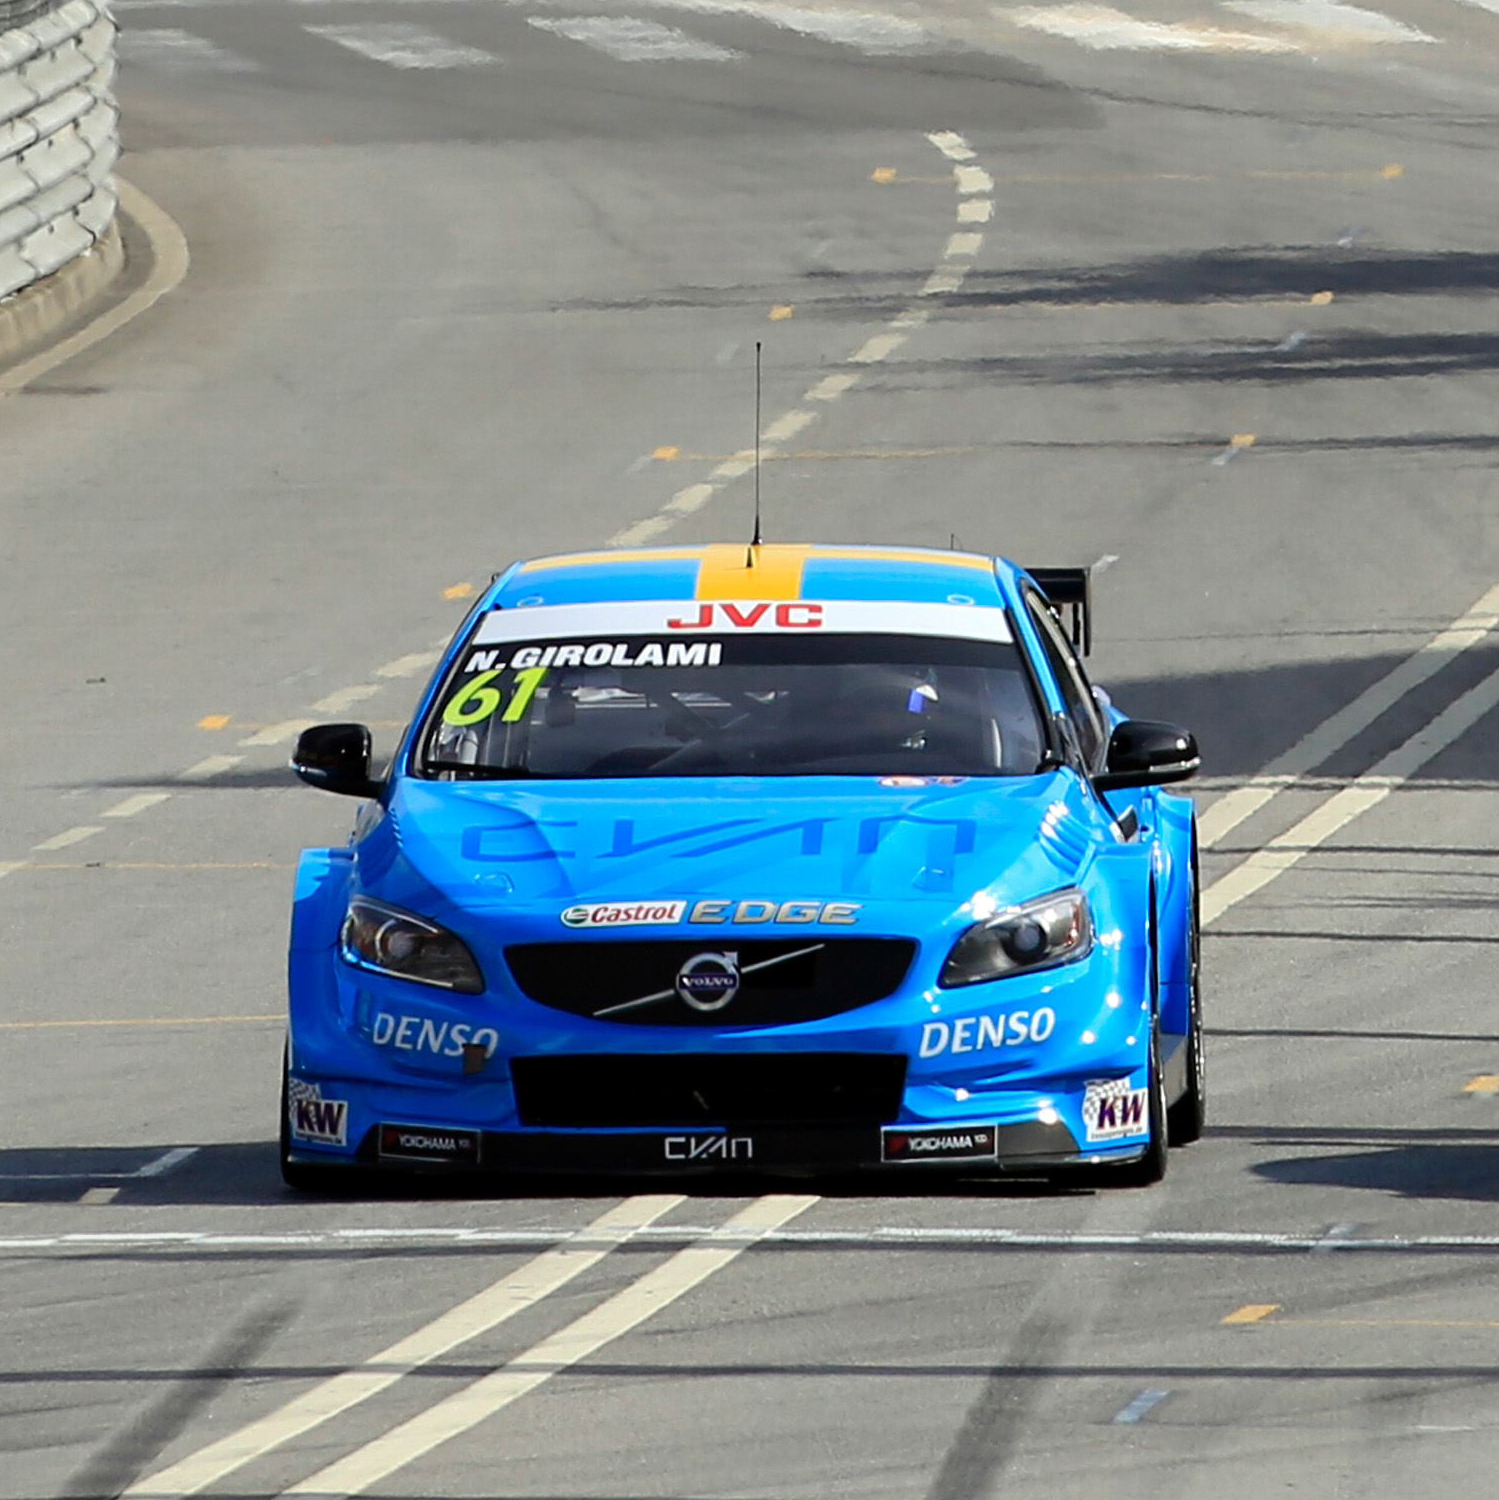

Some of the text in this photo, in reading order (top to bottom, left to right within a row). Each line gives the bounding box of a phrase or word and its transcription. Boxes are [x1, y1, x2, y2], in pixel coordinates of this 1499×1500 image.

[667, 603, 823, 629] JVC
[442, 666, 549, 727] 61
[590, 899, 864, 925] Castrol EDGE
[681, 976, 734, 987] VOLVO
[372, 1012, 499, 1060] DENSO
[918, 1006, 1056, 1059] DENSO
[296, 1100, 346, 1137] KW
[1096, 1091, 1146, 1131] KW
[399, 1134, 457, 1151] YOKOHAMA
[907, 1135, 974, 1152] YOKOHAMA
